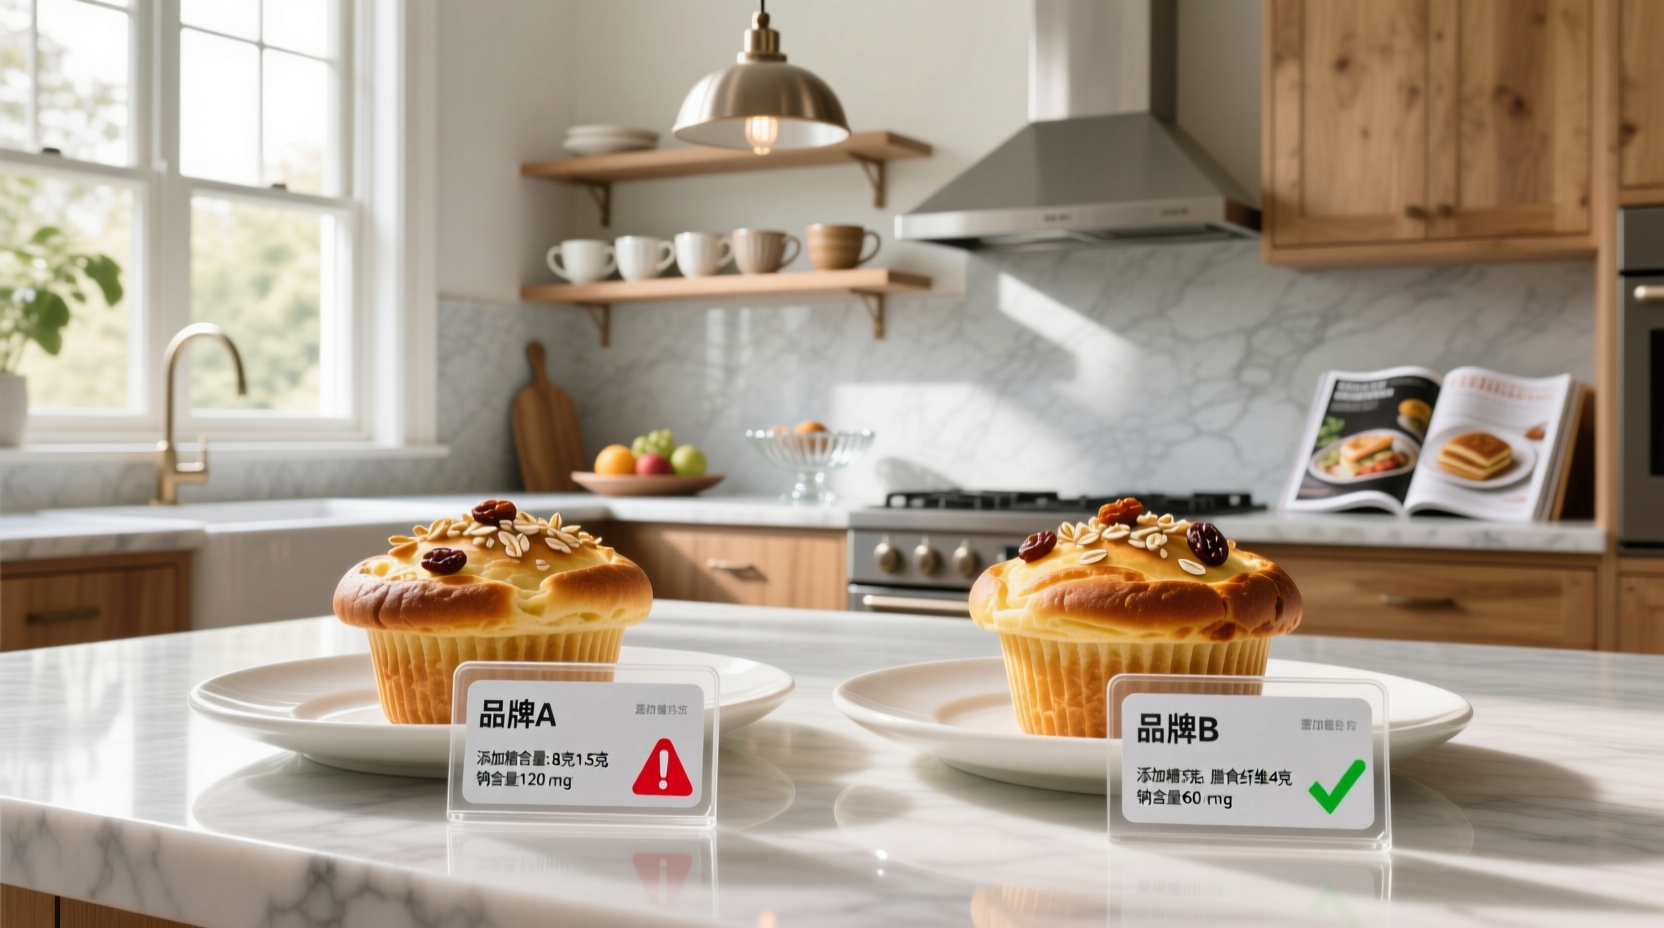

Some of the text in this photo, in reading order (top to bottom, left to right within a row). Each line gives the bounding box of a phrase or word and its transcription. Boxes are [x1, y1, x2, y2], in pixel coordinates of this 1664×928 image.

[480, 699, 556, 729] 品牌A
[1137, 713, 1219, 744] 品牌B
[549, 776, 573, 790] mg
[1207, 795, 1232, 809] mg
